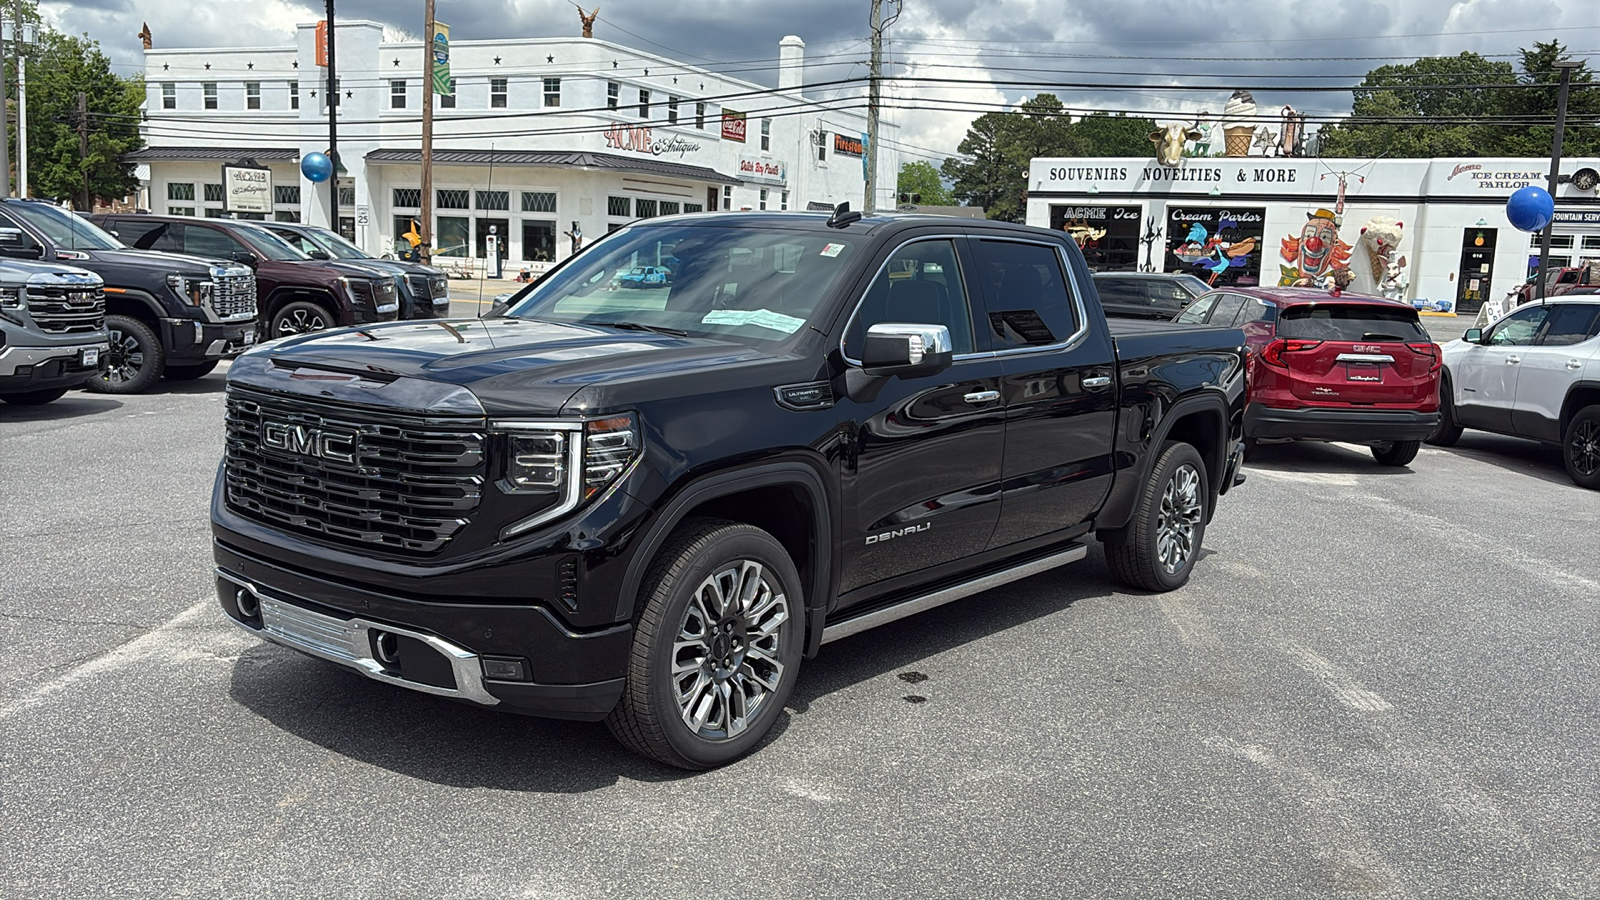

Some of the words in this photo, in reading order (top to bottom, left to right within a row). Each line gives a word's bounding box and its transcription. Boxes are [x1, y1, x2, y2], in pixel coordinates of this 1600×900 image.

[604, 121, 652, 154] ACME
[652, 133, 701, 159] Antiques
[835, 134, 862, 153] Fireston
[755, 161, 764, 176] Boy
[1050, 167, 1127, 181] SOUVENIRS
[1142, 167, 1222, 181] NOVELTIES
[1236, 168, 1247, 182] &
[1253, 168, 1297, 182] MORE
[1471, 172, 1493, 180] ICE
[1495, 172, 1542, 180] CREAM
[1479, 181, 1530, 189] PARLOR
[1064, 207, 1106, 219] ACME
[1114, 207, 1139, 219] Ice
[1172, 209, 1213, 221] Cream
[1219, 210, 1263, 222] Parlor
[1553, 212, 1583, 221] FOUNTAIN
[358, 216, 369, 224] 25
[1353, 345, 1381, 353] GMC
[263, 421, 354, 464] GMC
[865, 521, 931, 546] DENALI
